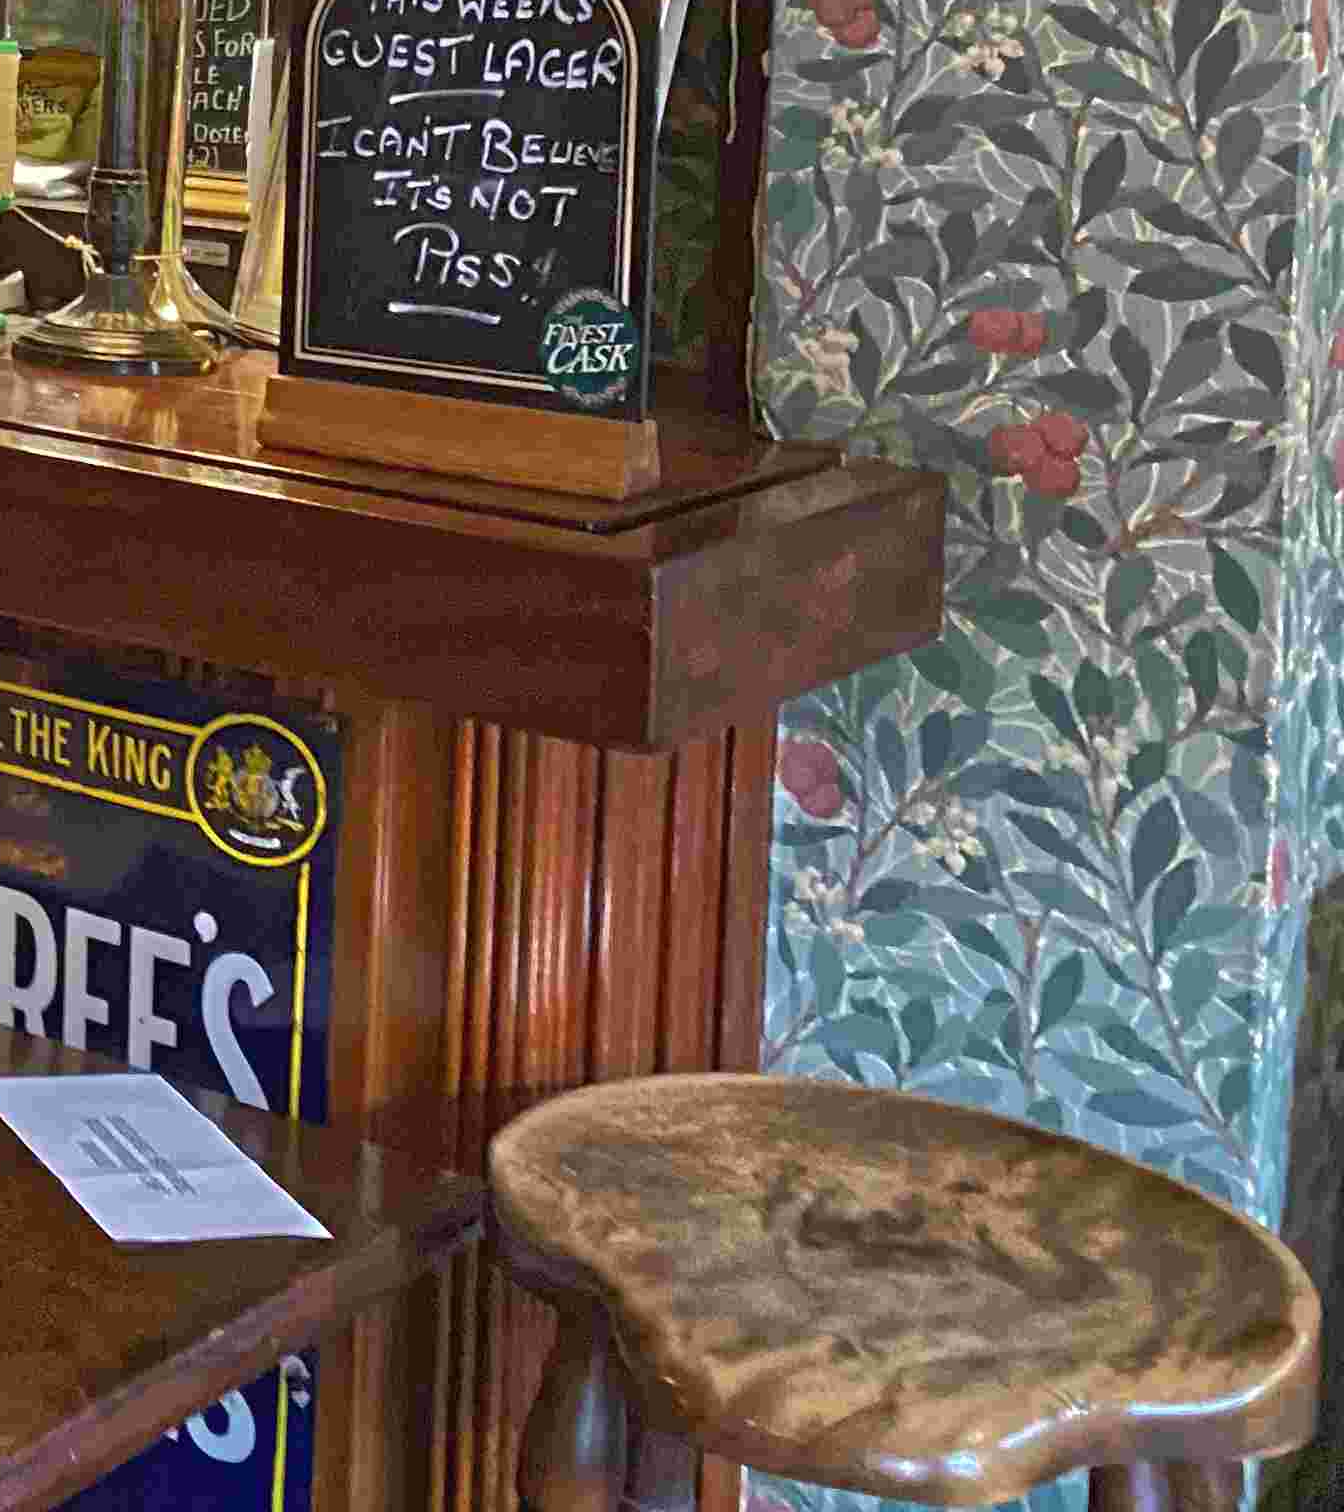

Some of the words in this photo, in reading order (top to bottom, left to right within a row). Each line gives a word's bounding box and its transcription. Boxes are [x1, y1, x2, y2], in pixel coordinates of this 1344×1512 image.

[323, 30, 474, 77] GUEST
[482, 38, 623, 88] LAGER
[193, 124, 251, 145] DOZE
[481, 119, 620, 173] BELIEVE
[469, 177, 578, 227] NOT
[544, 322, 625, 345] FINEST
[547, 343, 633, 375] CASK
[9, 709, 72, 768] THE
[87, 721, 172, 791] KING
